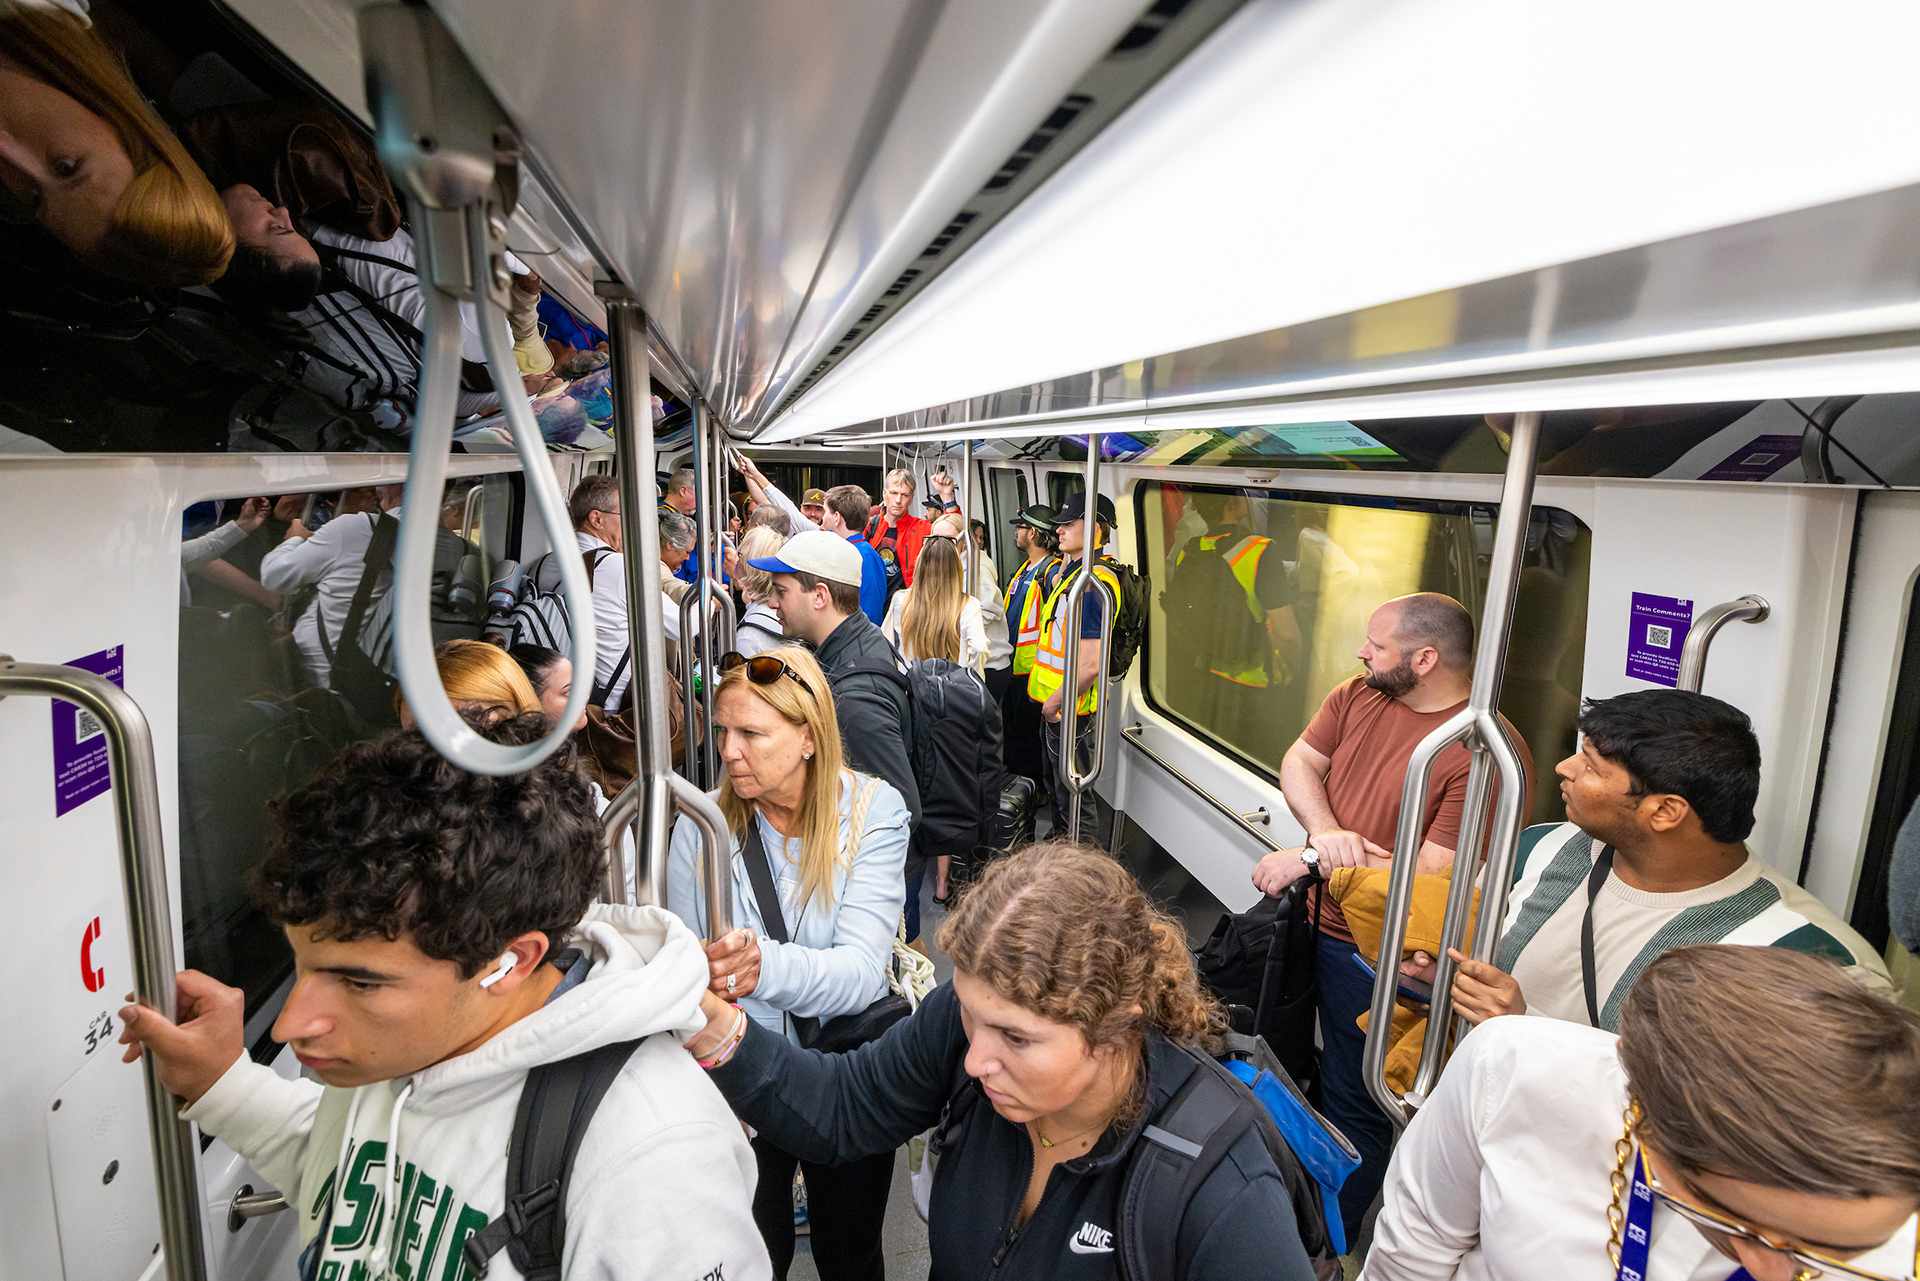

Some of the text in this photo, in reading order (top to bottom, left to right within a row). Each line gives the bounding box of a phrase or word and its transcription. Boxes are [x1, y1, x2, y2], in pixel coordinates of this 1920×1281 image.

[1652, 607, 1691, 618] Comments?
[89, 1010, 107, 1030] CAR
[84, 1015, 114, 1056] 34
[1078, 1221, 1114, 1248] NIKE
